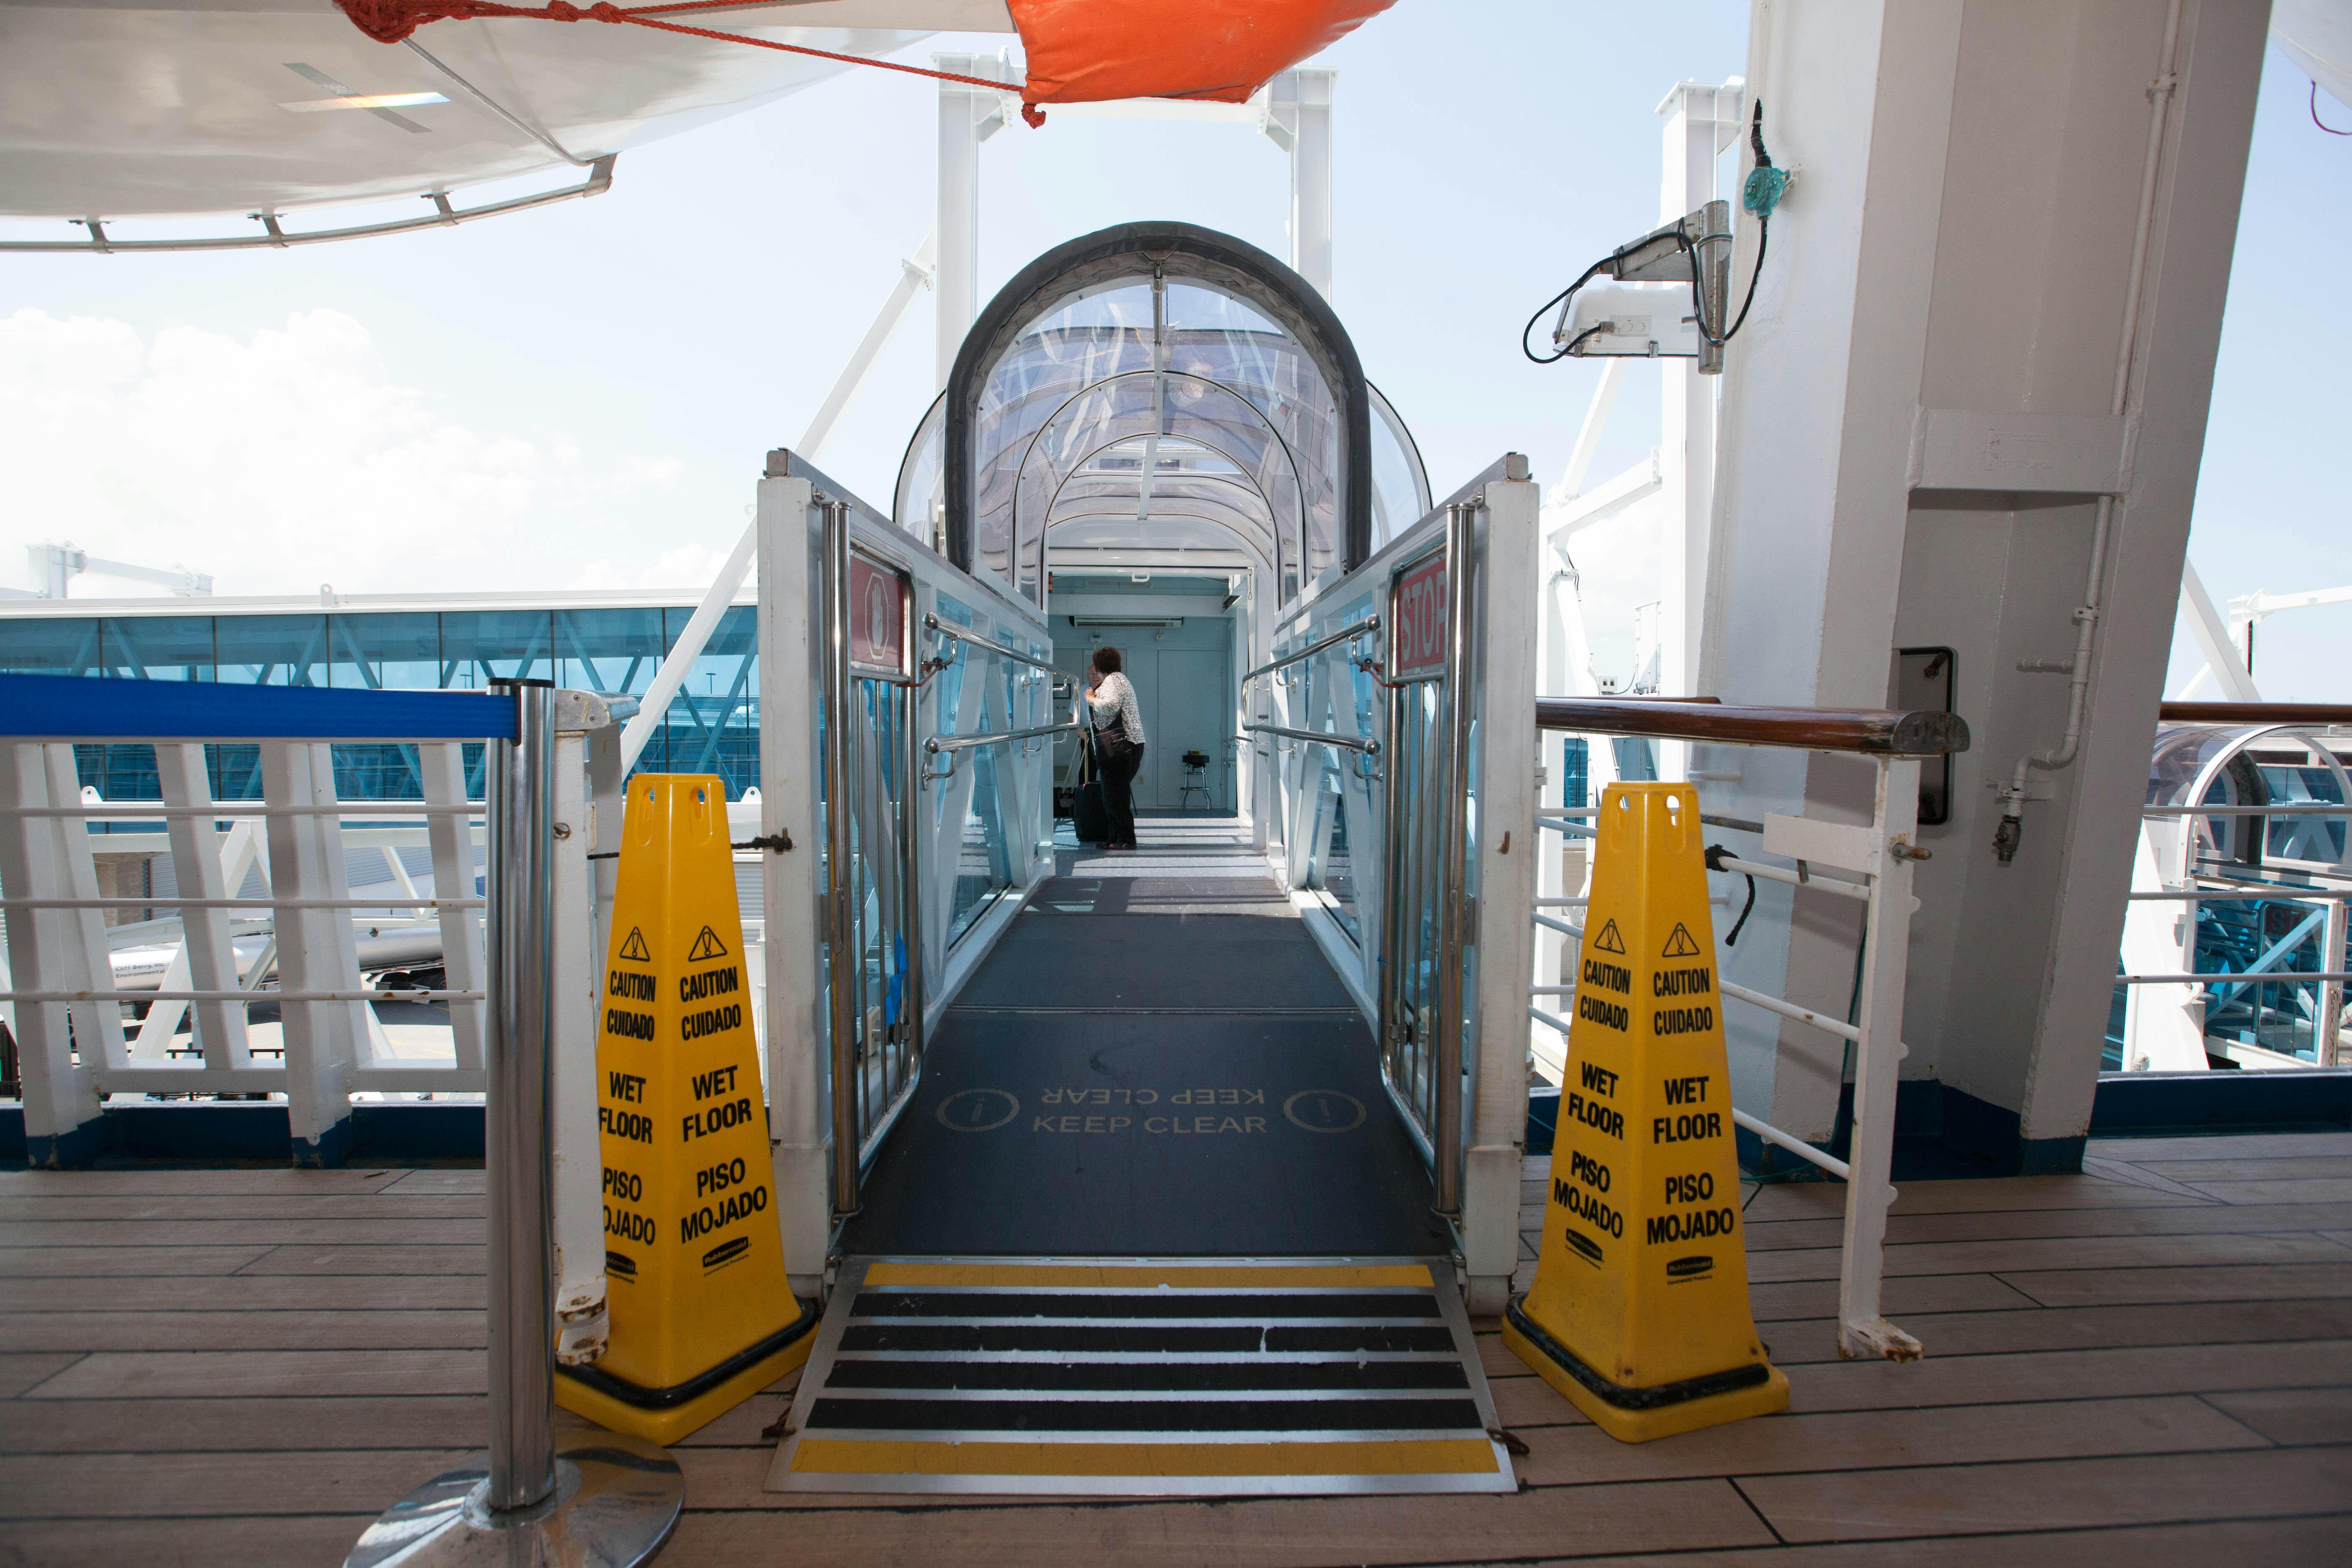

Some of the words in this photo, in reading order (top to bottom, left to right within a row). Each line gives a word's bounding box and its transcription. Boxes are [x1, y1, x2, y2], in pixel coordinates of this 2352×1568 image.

[1401, 570, 1447, 662] STOP
[2272, 909, 2300, 932] ST
[116, 969, 165, 978] Environmental
[610, 970, 656, 1002] CAUTION
[680, 967, 738, 1003] CAUTION
[1584, 959, 1631, 995] CAUTION
[1653, 968, 1710, 997] CAUTION
[607, 1008, 655, 1042] CUIDADO
[681, 1003, 741, 1041] CUIDADO
[1580, 995, 1628, 1032] CUIDADO
[1654, 1006, 1713, 1036] CUIDADO
[609, 1071, 646, 1104] WET
[692, 1065, 738, 1101] WET
[1041, 1088, 1158, 1104] CLEAR
[1171, 1089, 1264, 1104] KEEP
[1582, 1061, 1619, 1099] WET
[1664, 1076, 1710, 1105] WET
[599, 1106, 652, 1144] FLOOR
[682, 1098, 752, 1142] FLOOR
[1033, 1116, 1131, 1133] KEEP
[1144, 1116, 1268, 1133] CLEAR
[1568, 1092, 1624, 1140] FLOOR
[1653, 1112, 1722, 1144] FLOOR
[602, 1167, 642, 1202] PISO
[696, 1158, 745, 1198] PISO
[1571, 1150, 1611, 1193] PISO
[1666, 1172, 1714, 1204] PISO
[681, 1186, 767, 1244] MOJADO
[1554, 1177, 1623, 1238] MOJADO
[603, 1205, 655, 1246] OJADO
[1647, 1207, 1734, 1245] MOJADO
[704, 1240, 747, 1264] Rubbermaid
[1568, 1233, 1601, 1257] Rubbermaid
[1669, 1260, 1711, 1272] Rubbermaid
